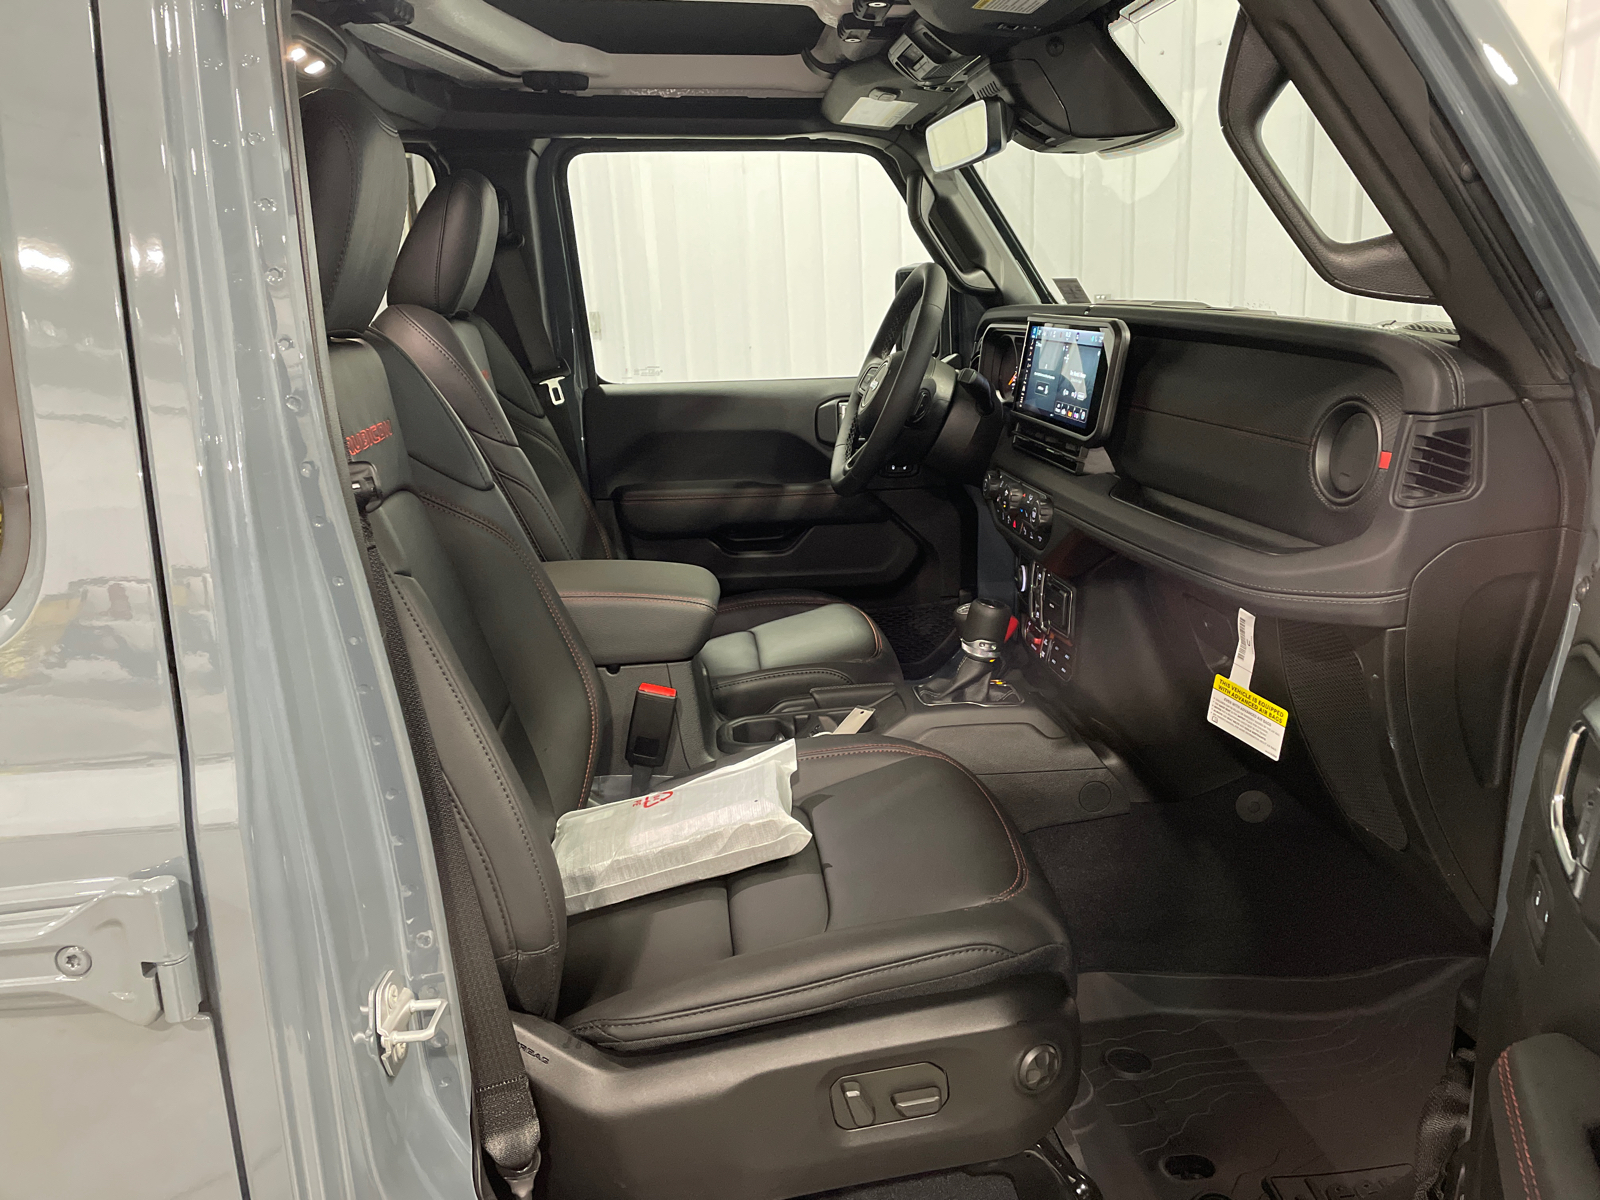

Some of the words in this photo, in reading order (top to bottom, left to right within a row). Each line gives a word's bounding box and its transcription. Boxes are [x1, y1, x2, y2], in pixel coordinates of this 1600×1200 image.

[1218, 684, 1231, 696] WITH
[1231, 692, 1258, 710] ADVANCED
[1259, 706, 1268, 715] AIR
[1268, 713, 1283, 724] BAGS
[1219, 679, 1231, 689] THIS
[1231, 685, 1252, 700] VEHICLE
[1258, 700, 1284, 718] EQUIPPED
